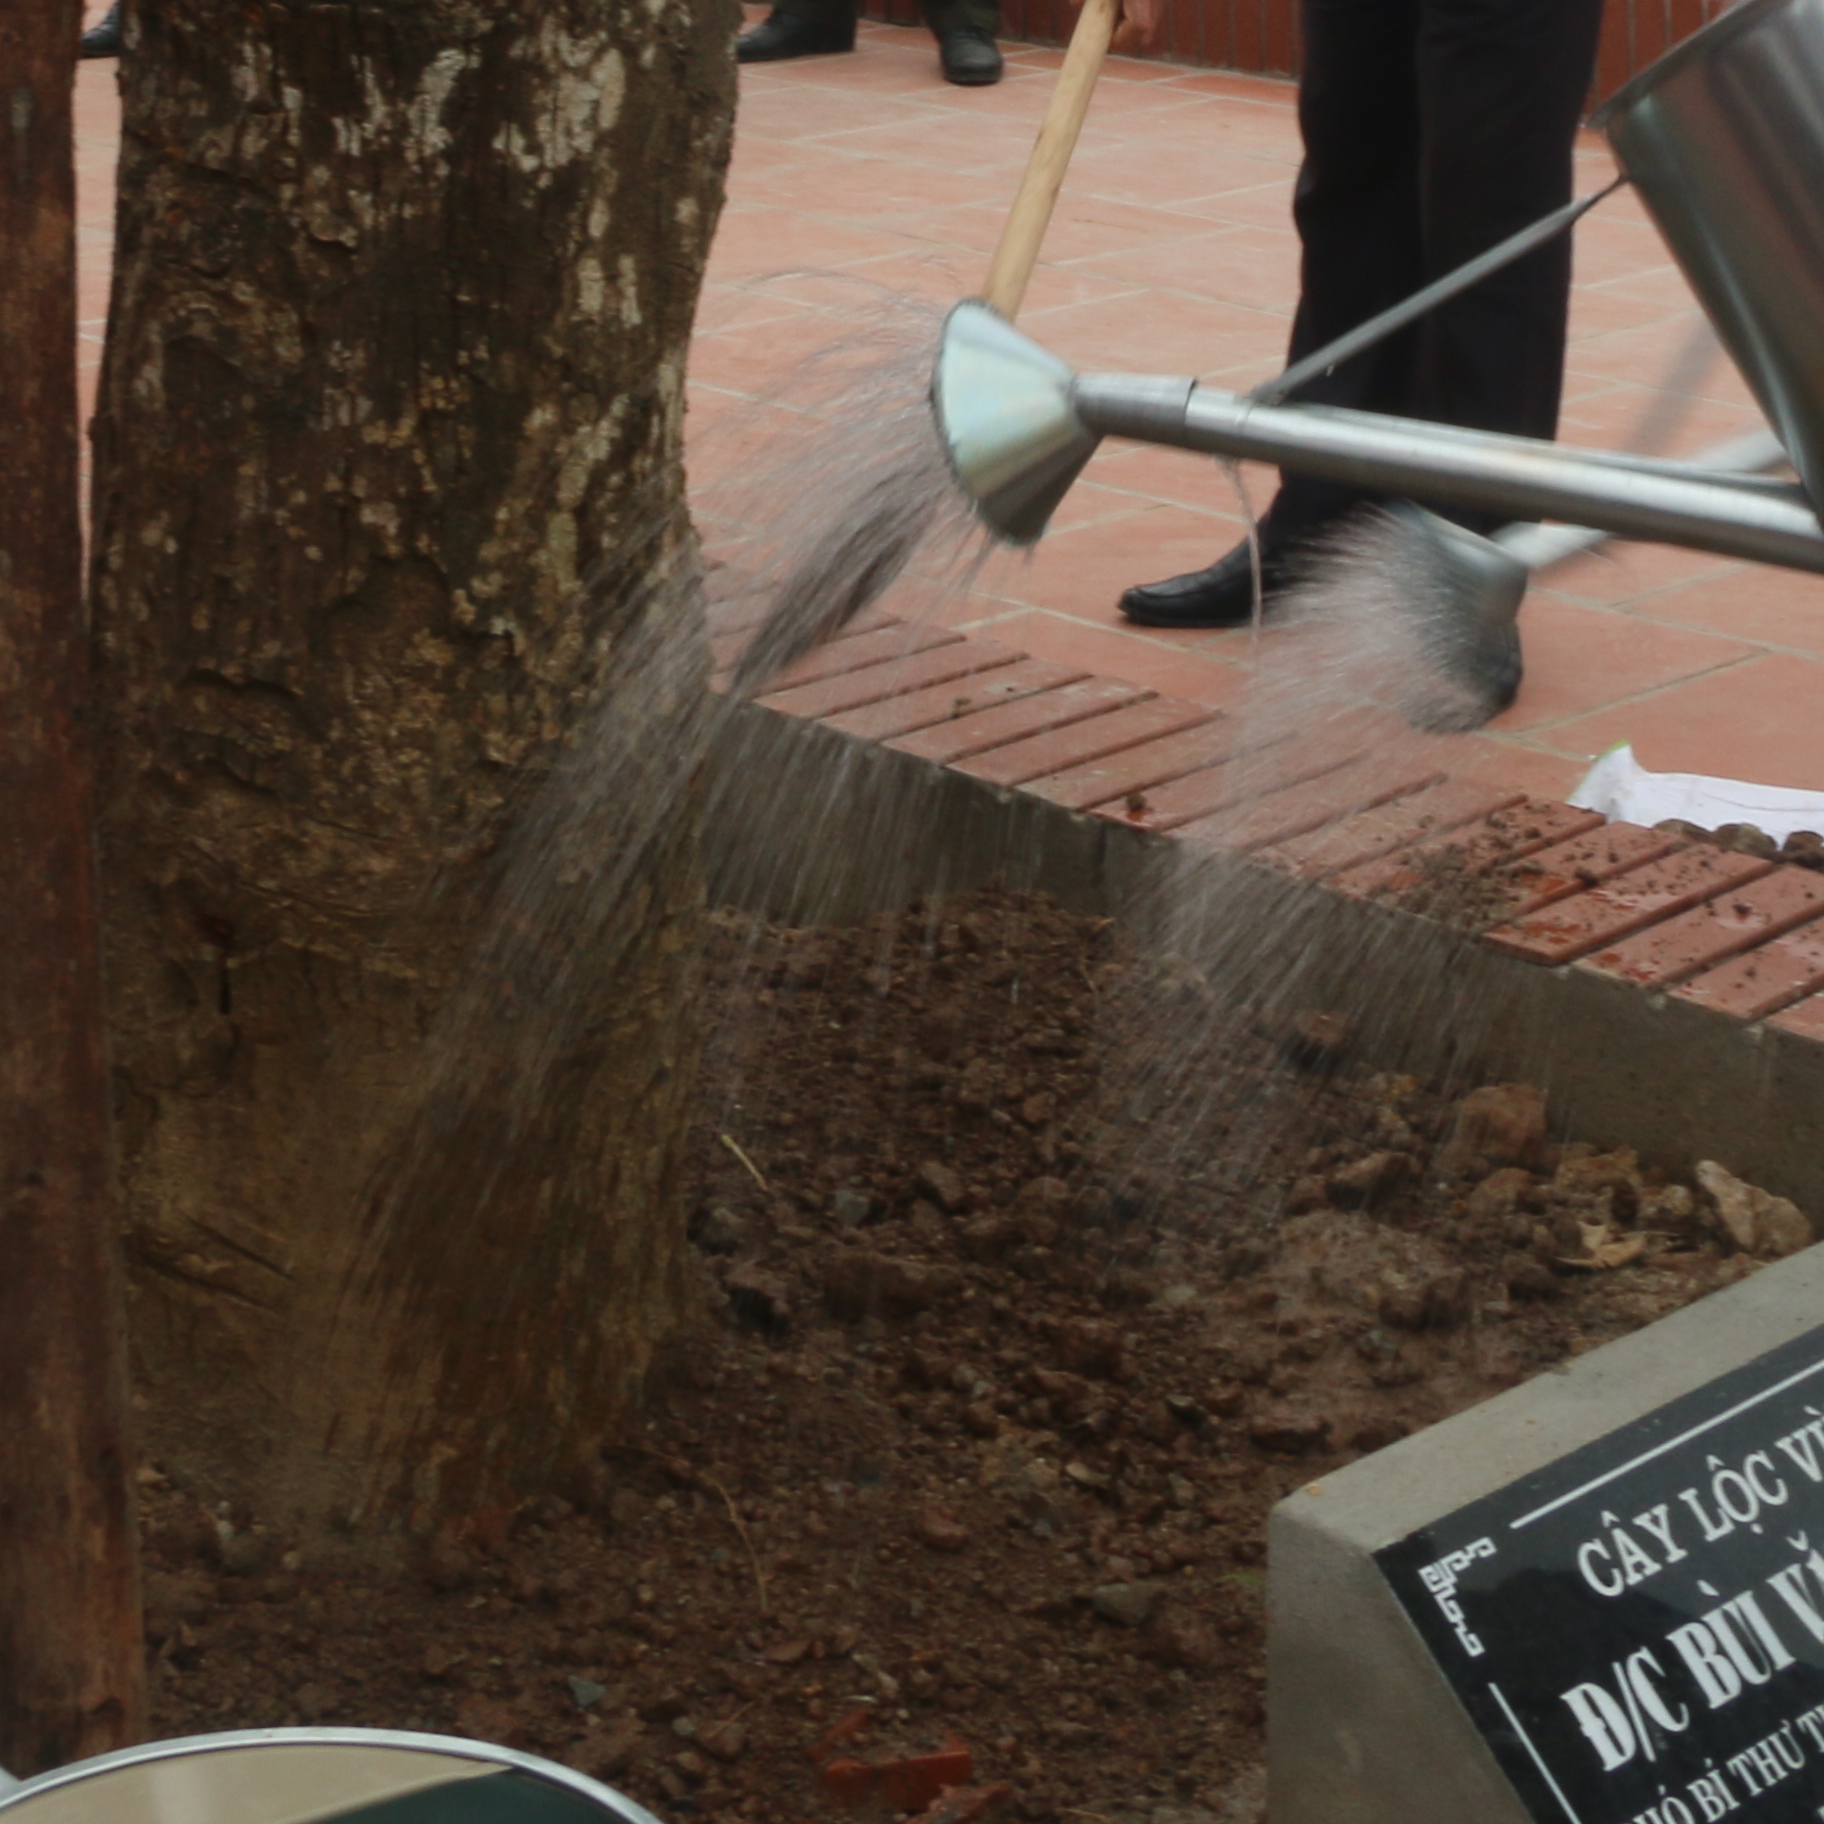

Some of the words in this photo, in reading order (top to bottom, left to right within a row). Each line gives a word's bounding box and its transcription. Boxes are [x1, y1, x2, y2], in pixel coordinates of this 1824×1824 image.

[1577, 1503, 1688, 1598] CÂY
[1677, 1449, 1789, 1543] LỘC
[1560, 1645, 1690, 1772] Đ/C
[1665, 1579, 1797, 1710] BÙI
[1686, 1757, 1741, 1824] BÍ
[1726, 1719, 1806, 1796] THƯ
